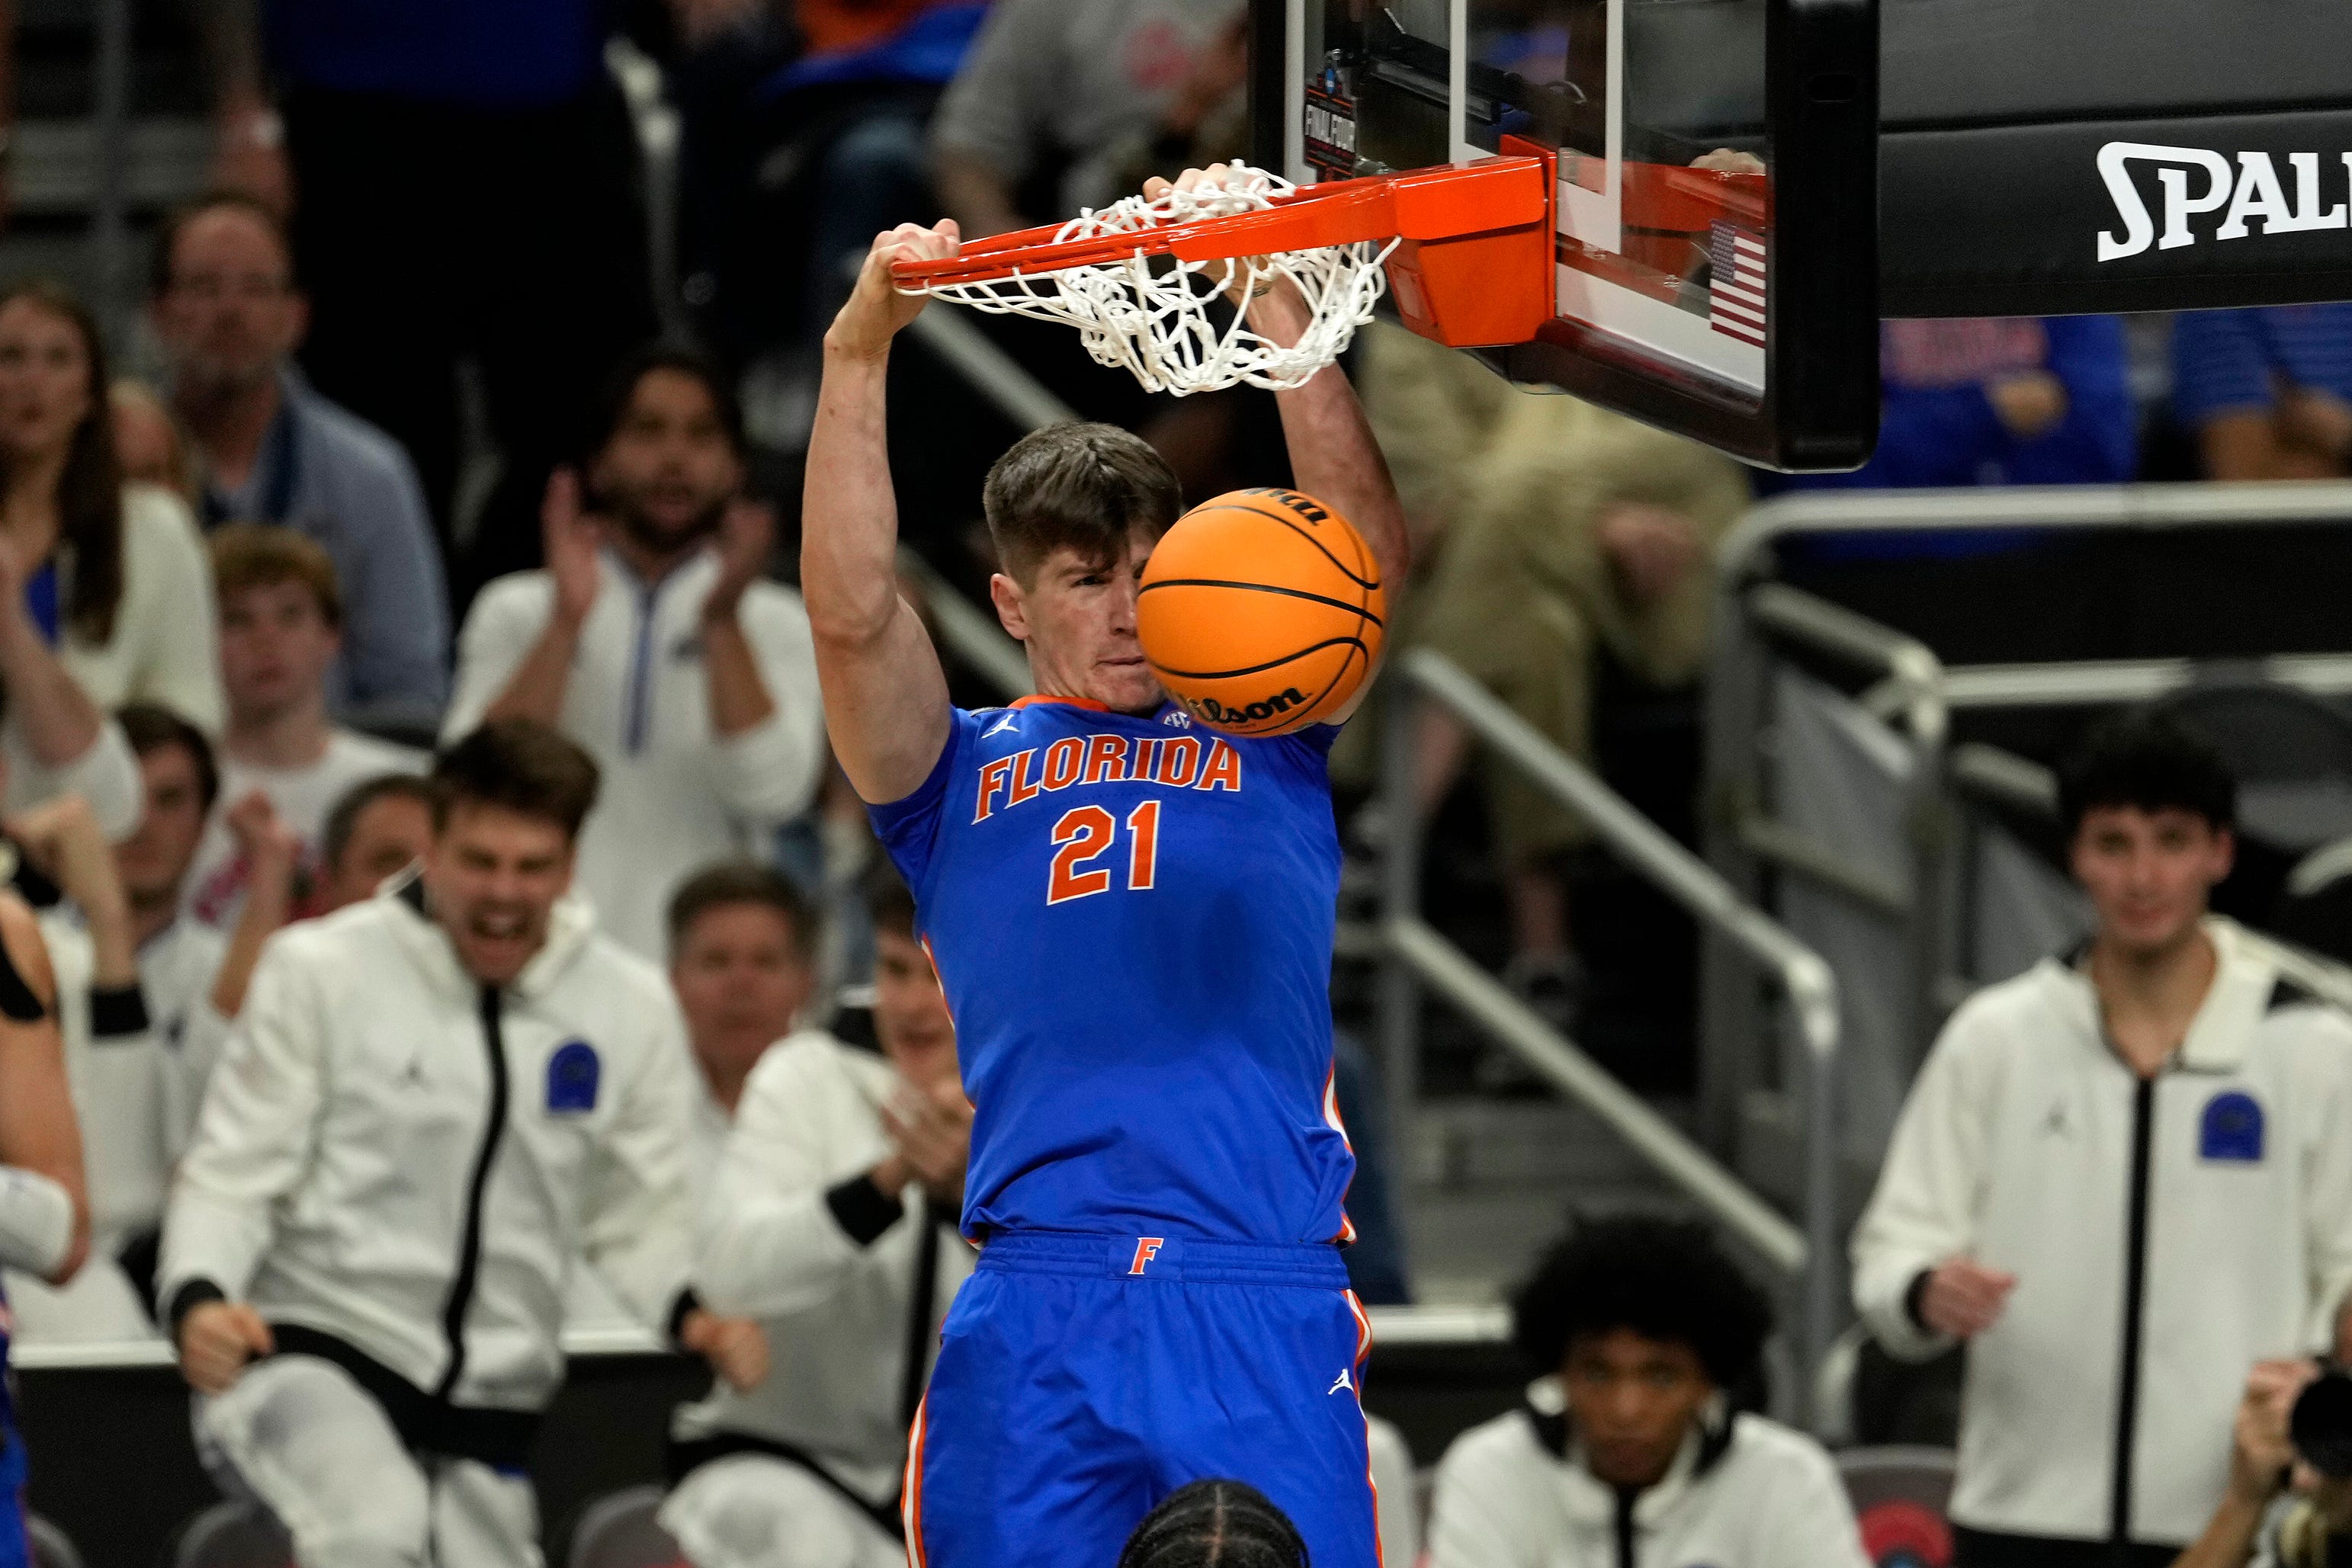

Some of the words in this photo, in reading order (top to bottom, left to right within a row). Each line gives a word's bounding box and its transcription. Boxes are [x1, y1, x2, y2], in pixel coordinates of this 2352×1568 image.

[2097, 141, 2352, 262] SPAL
[1179, 688, 1307, 723] ilson
[971, 734, 1241, 825] FLORIDA
[1046, 800, 1161, 906] 21
[1127, 1236, 1164, 1275] F
